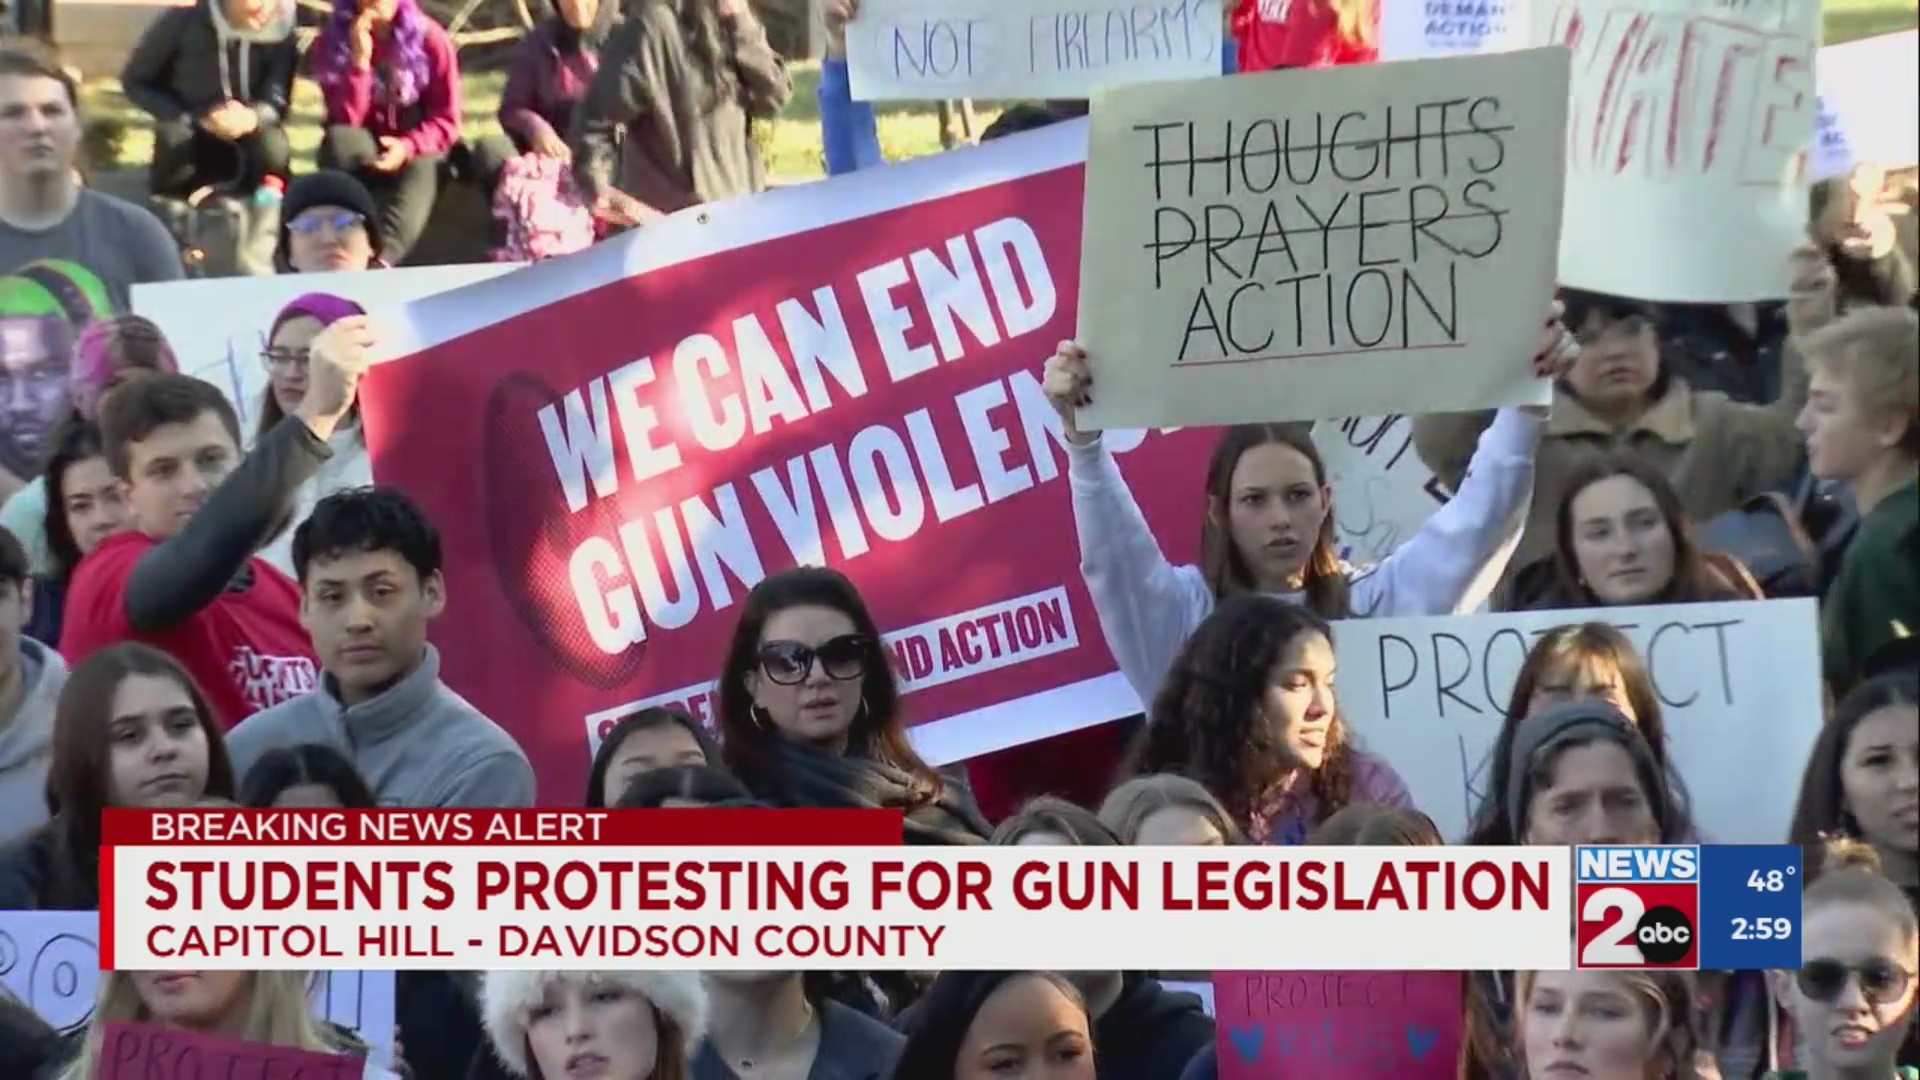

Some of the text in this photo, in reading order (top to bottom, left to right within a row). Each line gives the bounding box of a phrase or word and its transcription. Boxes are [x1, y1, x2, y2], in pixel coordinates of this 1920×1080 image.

[893, 0, 1214, 76] NOT FIREARMS
[1133, 96, 1510, 199] THOUGHTS
[1145, 178, 1506, 288] PRAYERS
[1178, 262, 1457, 361] ACTION
[537, 216, 1058, 514] WE CAN END
[567, 366, 1184, 656] GUN VIOLEN
[938, 596, 1068, 673] ACTION
[1379, 619, 1745, 720] PROCT
